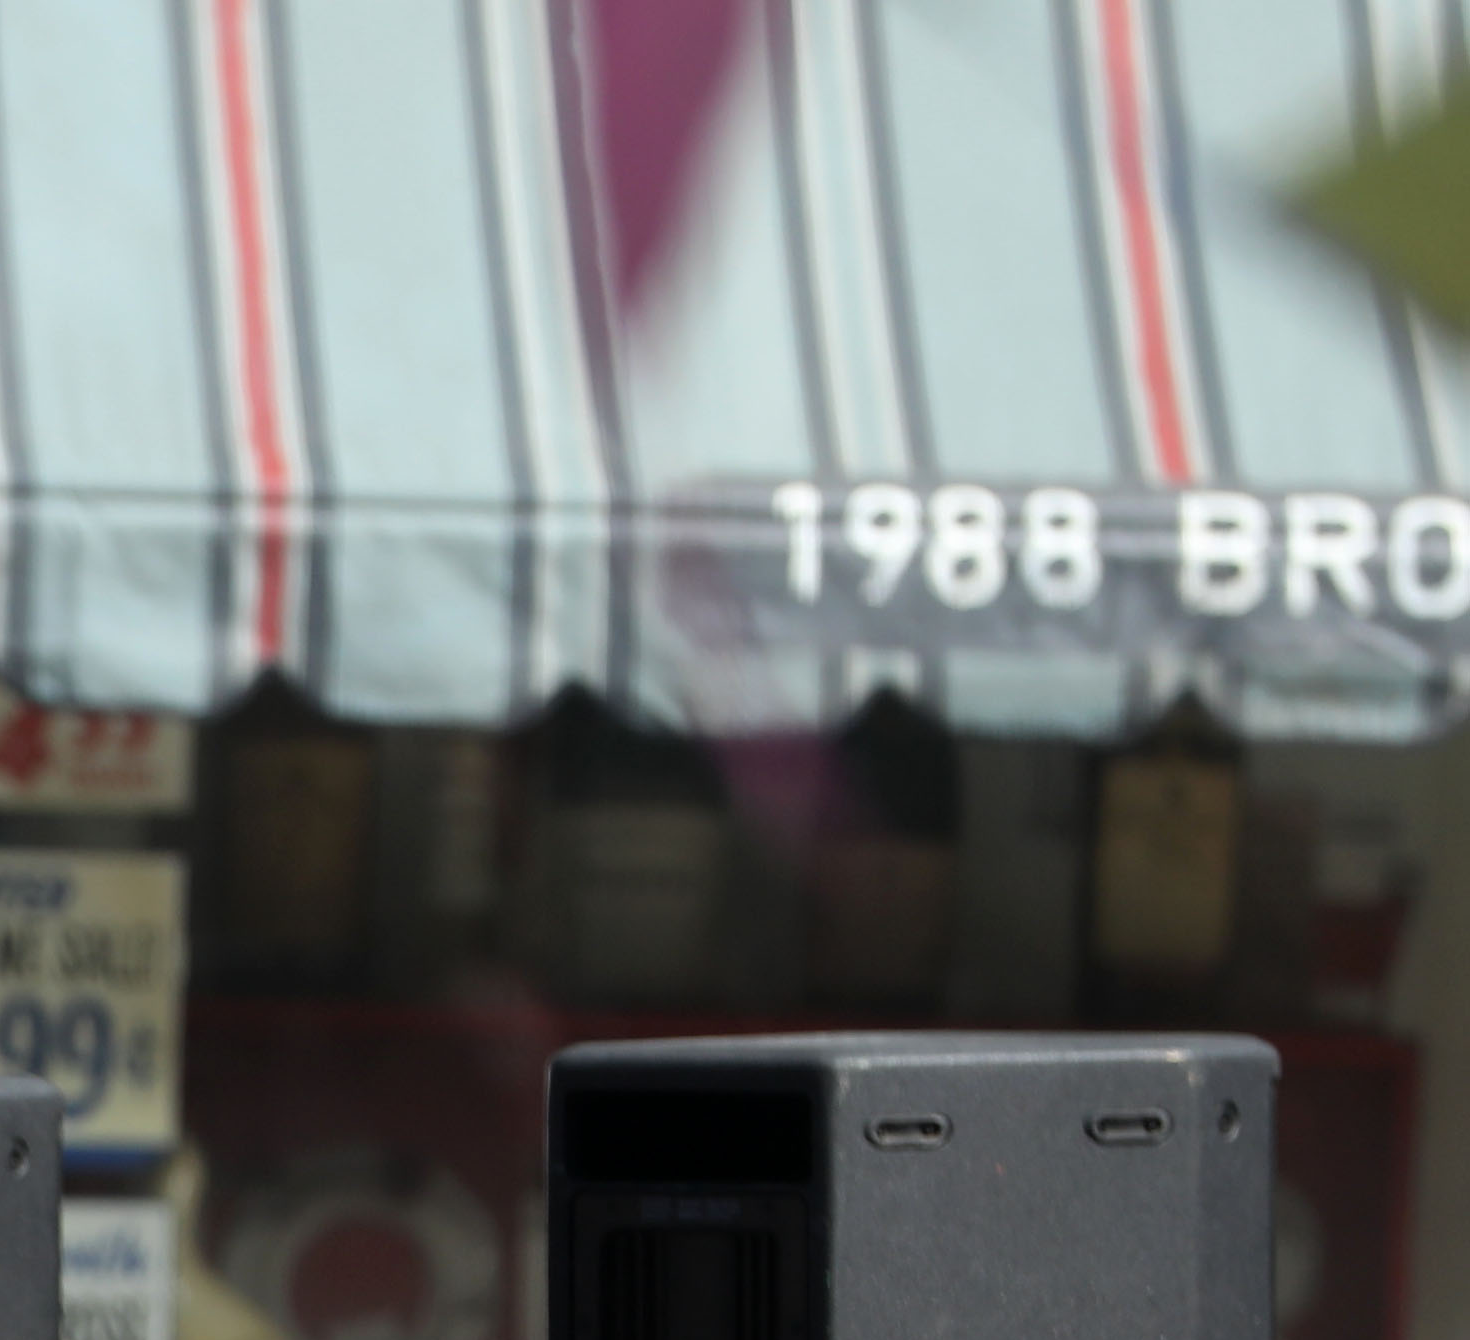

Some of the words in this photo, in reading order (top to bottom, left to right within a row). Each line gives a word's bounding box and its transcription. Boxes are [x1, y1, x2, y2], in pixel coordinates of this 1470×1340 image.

[772, 482, 1102, 609] 1988
[1177, 490, 1470, 620] BRO
[56, 918, 159, 986] SALE
